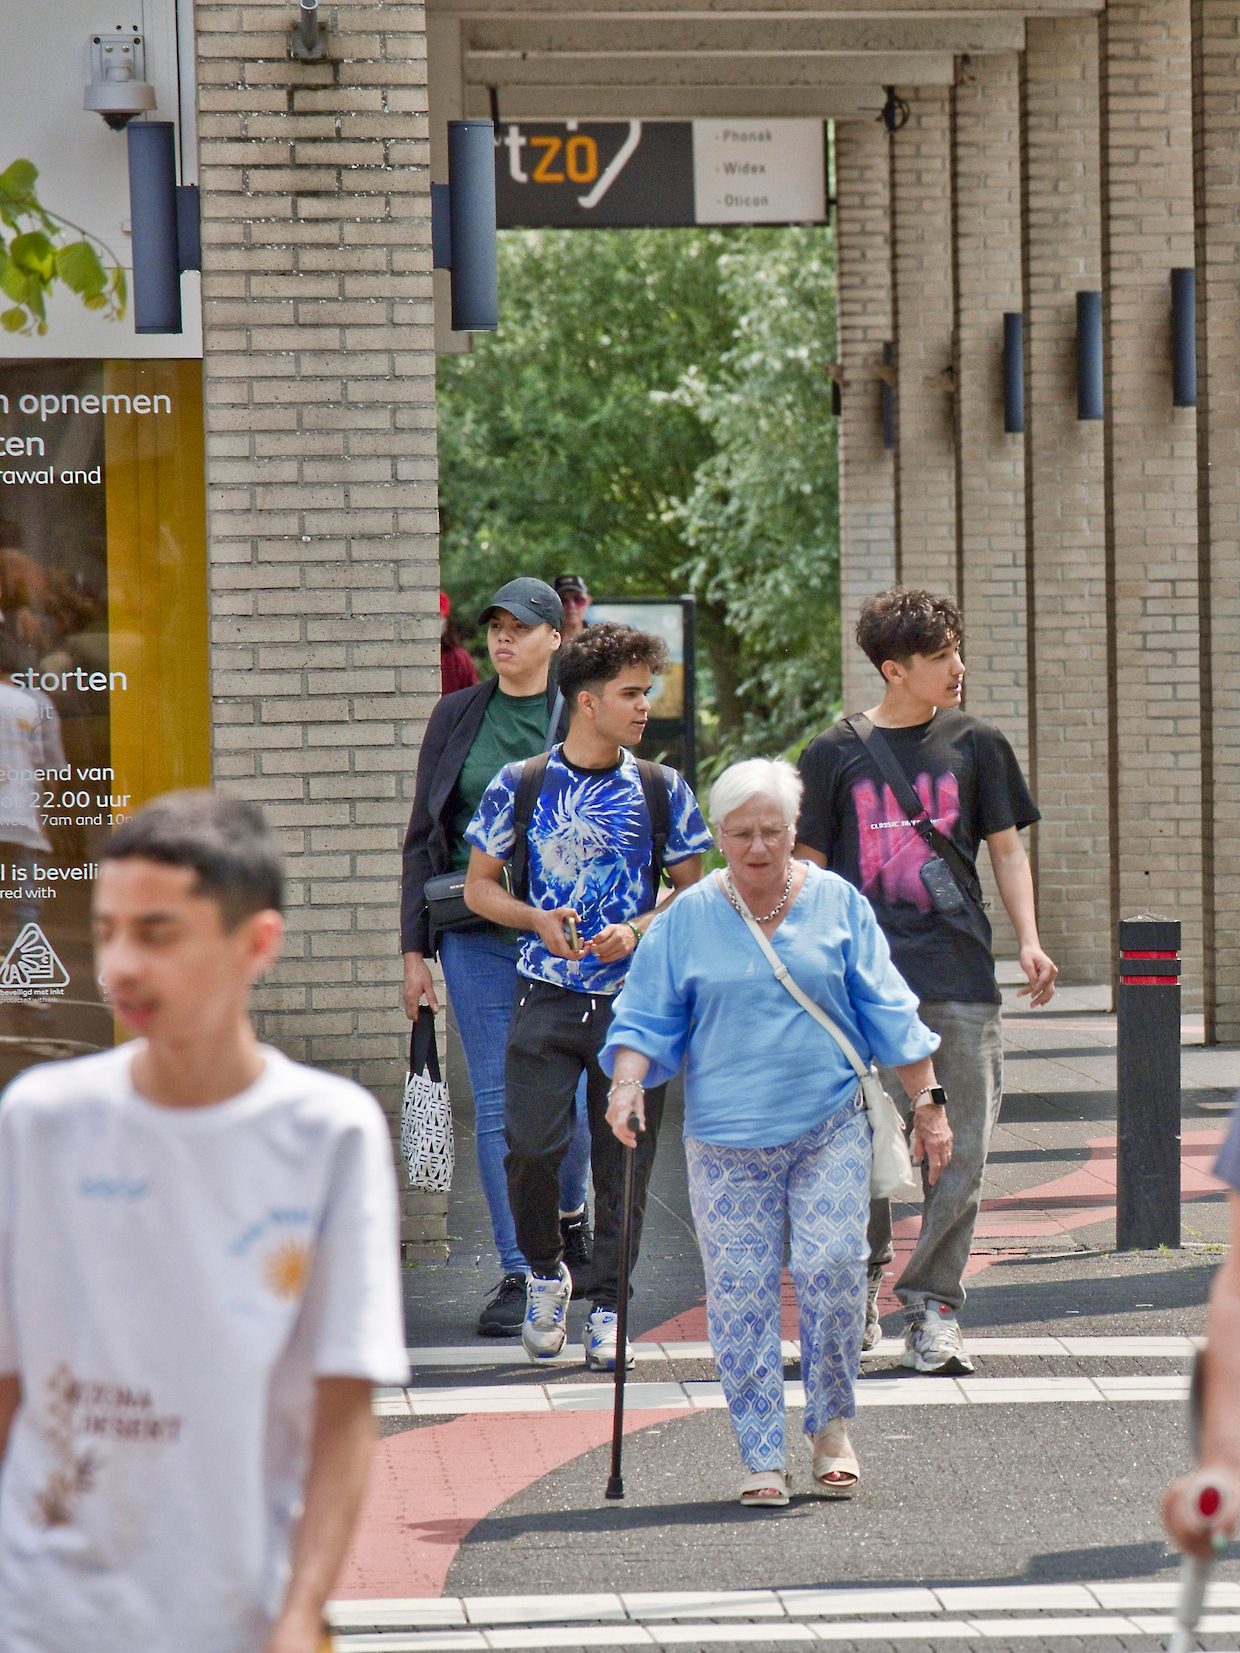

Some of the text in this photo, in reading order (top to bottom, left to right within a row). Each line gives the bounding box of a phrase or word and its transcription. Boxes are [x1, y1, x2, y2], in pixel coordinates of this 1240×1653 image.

[723, 162, 766, 174] Widex
[724, 193, 769, 207] Oticon
[19, 394, 171, 421] opnemen
[60, 465, 101, 485] and
[10, 667, 127, 692] storten
[76, 767, 115, 781] van
[28, 790, 91, 808] 22.00
[96, 794, 132, 808] uur
[40, 814, 73, 826] 7am
[75, 813, 102, 826] and
[870, 821, 900, 830] CLASSIC
[11, 863, 28, 881] is
[33, 862, 99, 881] beveili
[25, 886, 57, 899] with
